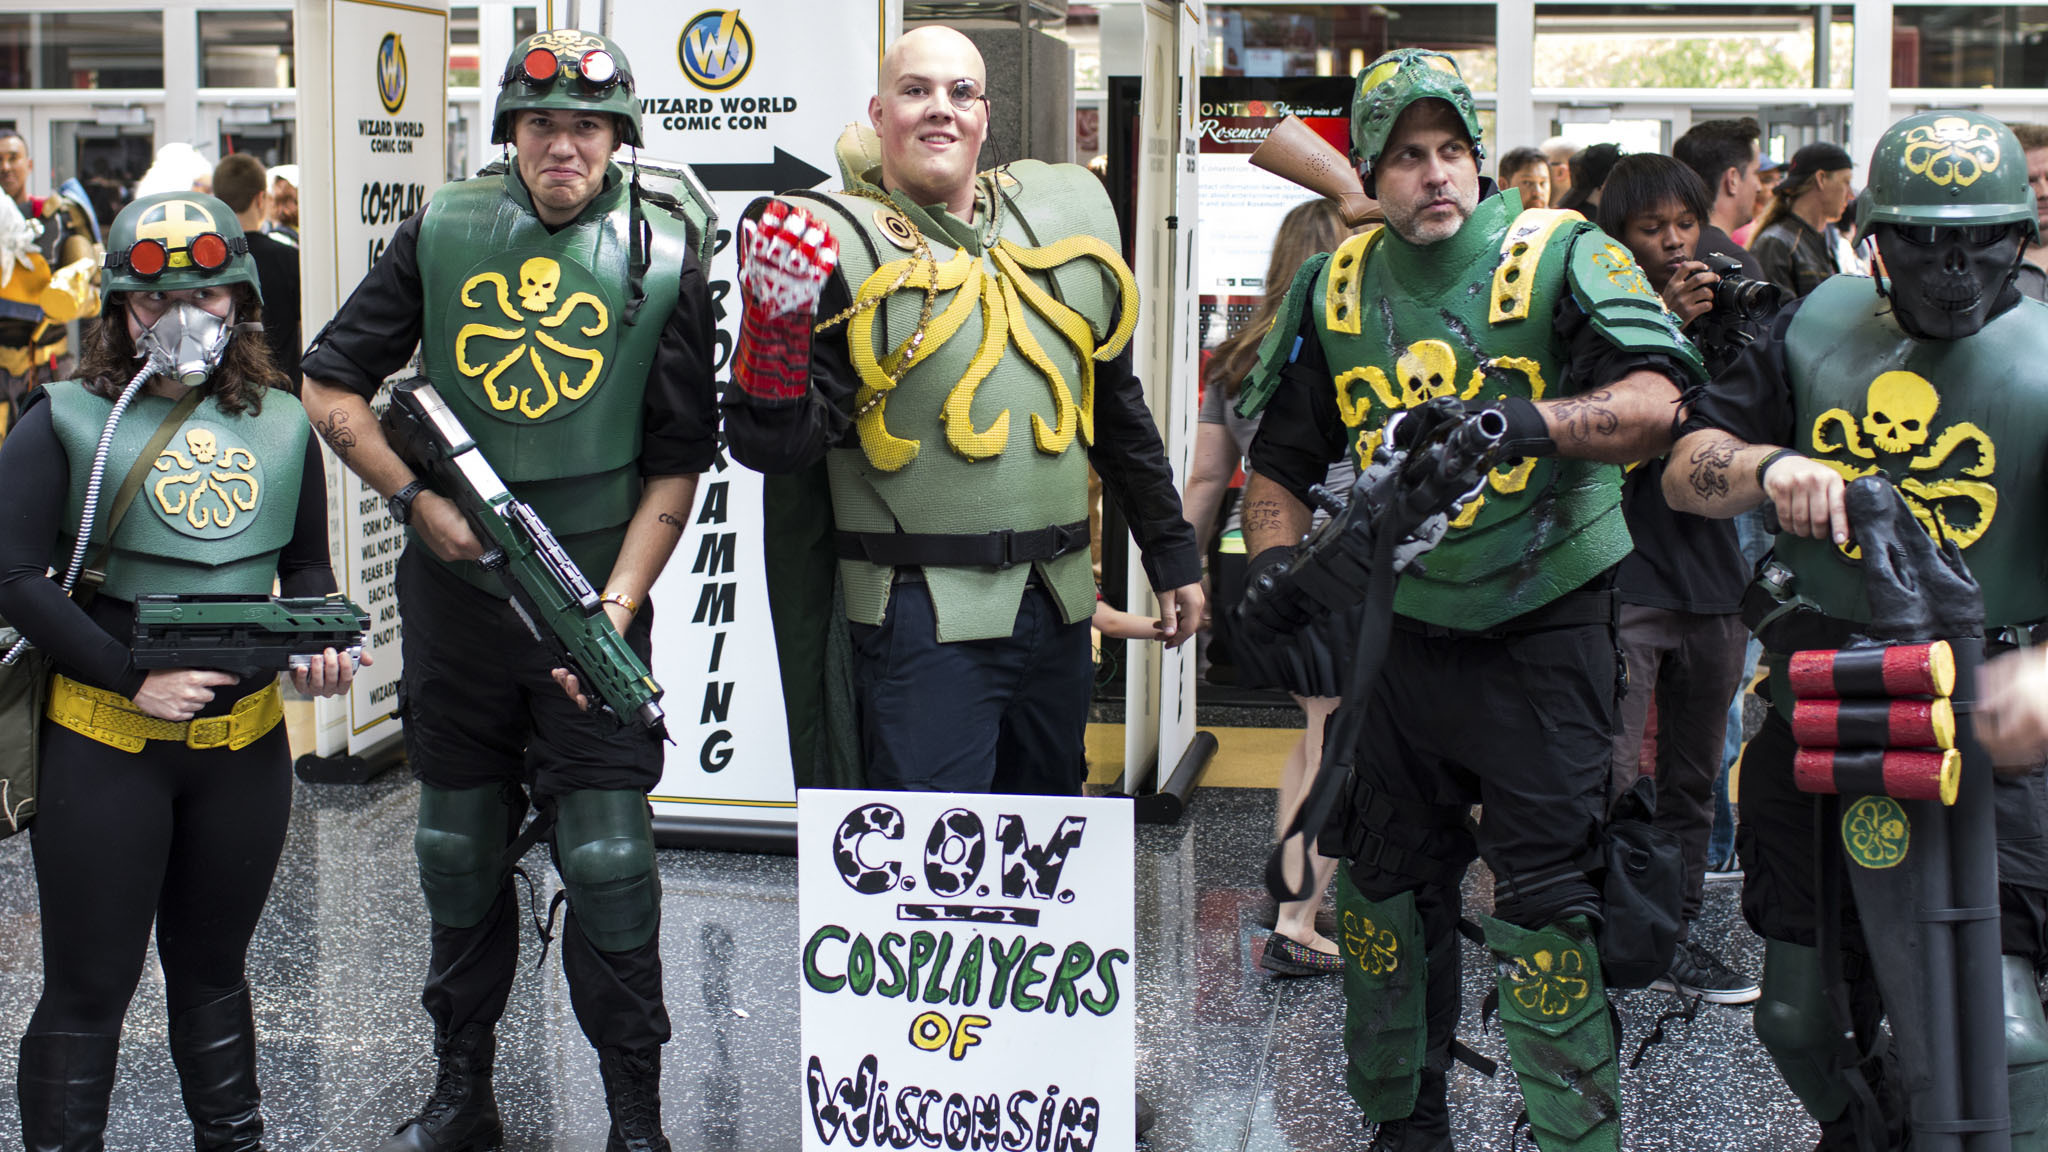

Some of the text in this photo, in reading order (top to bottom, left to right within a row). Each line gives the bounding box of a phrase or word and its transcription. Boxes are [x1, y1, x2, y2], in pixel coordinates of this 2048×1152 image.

[720, 97, 798, 114] WORLD
[358, 119, 425, 138] WIZARD WORLD
[662, 116, 767, 130] COMIC CON
[370, 138, 413, 154] COMIC CON
[360, 181, 425, 226] COSPLAY
[360, 496, 378, 516] RIGHT
[363, 518, 381, 537] FORM
[383, 515, 392, 531] OF
[361, 543, 376, 560] WILL
[378, 537, 392, 555] NOT
[394, 534, 402, 550] BE
[361, 562, 383, 584] PLEASE
[385, 560, 393, 576] BE
[368, 585, 386, 605] EACH
[380, 605, 395, 622] AND
[373, 627, 395, 649] ENJOY
[833, 802, 1087, 904] C.O.W.
[802, 924, 1130, 1017] COSPLAYERS
[908, 1010, 992, 1061] OF
